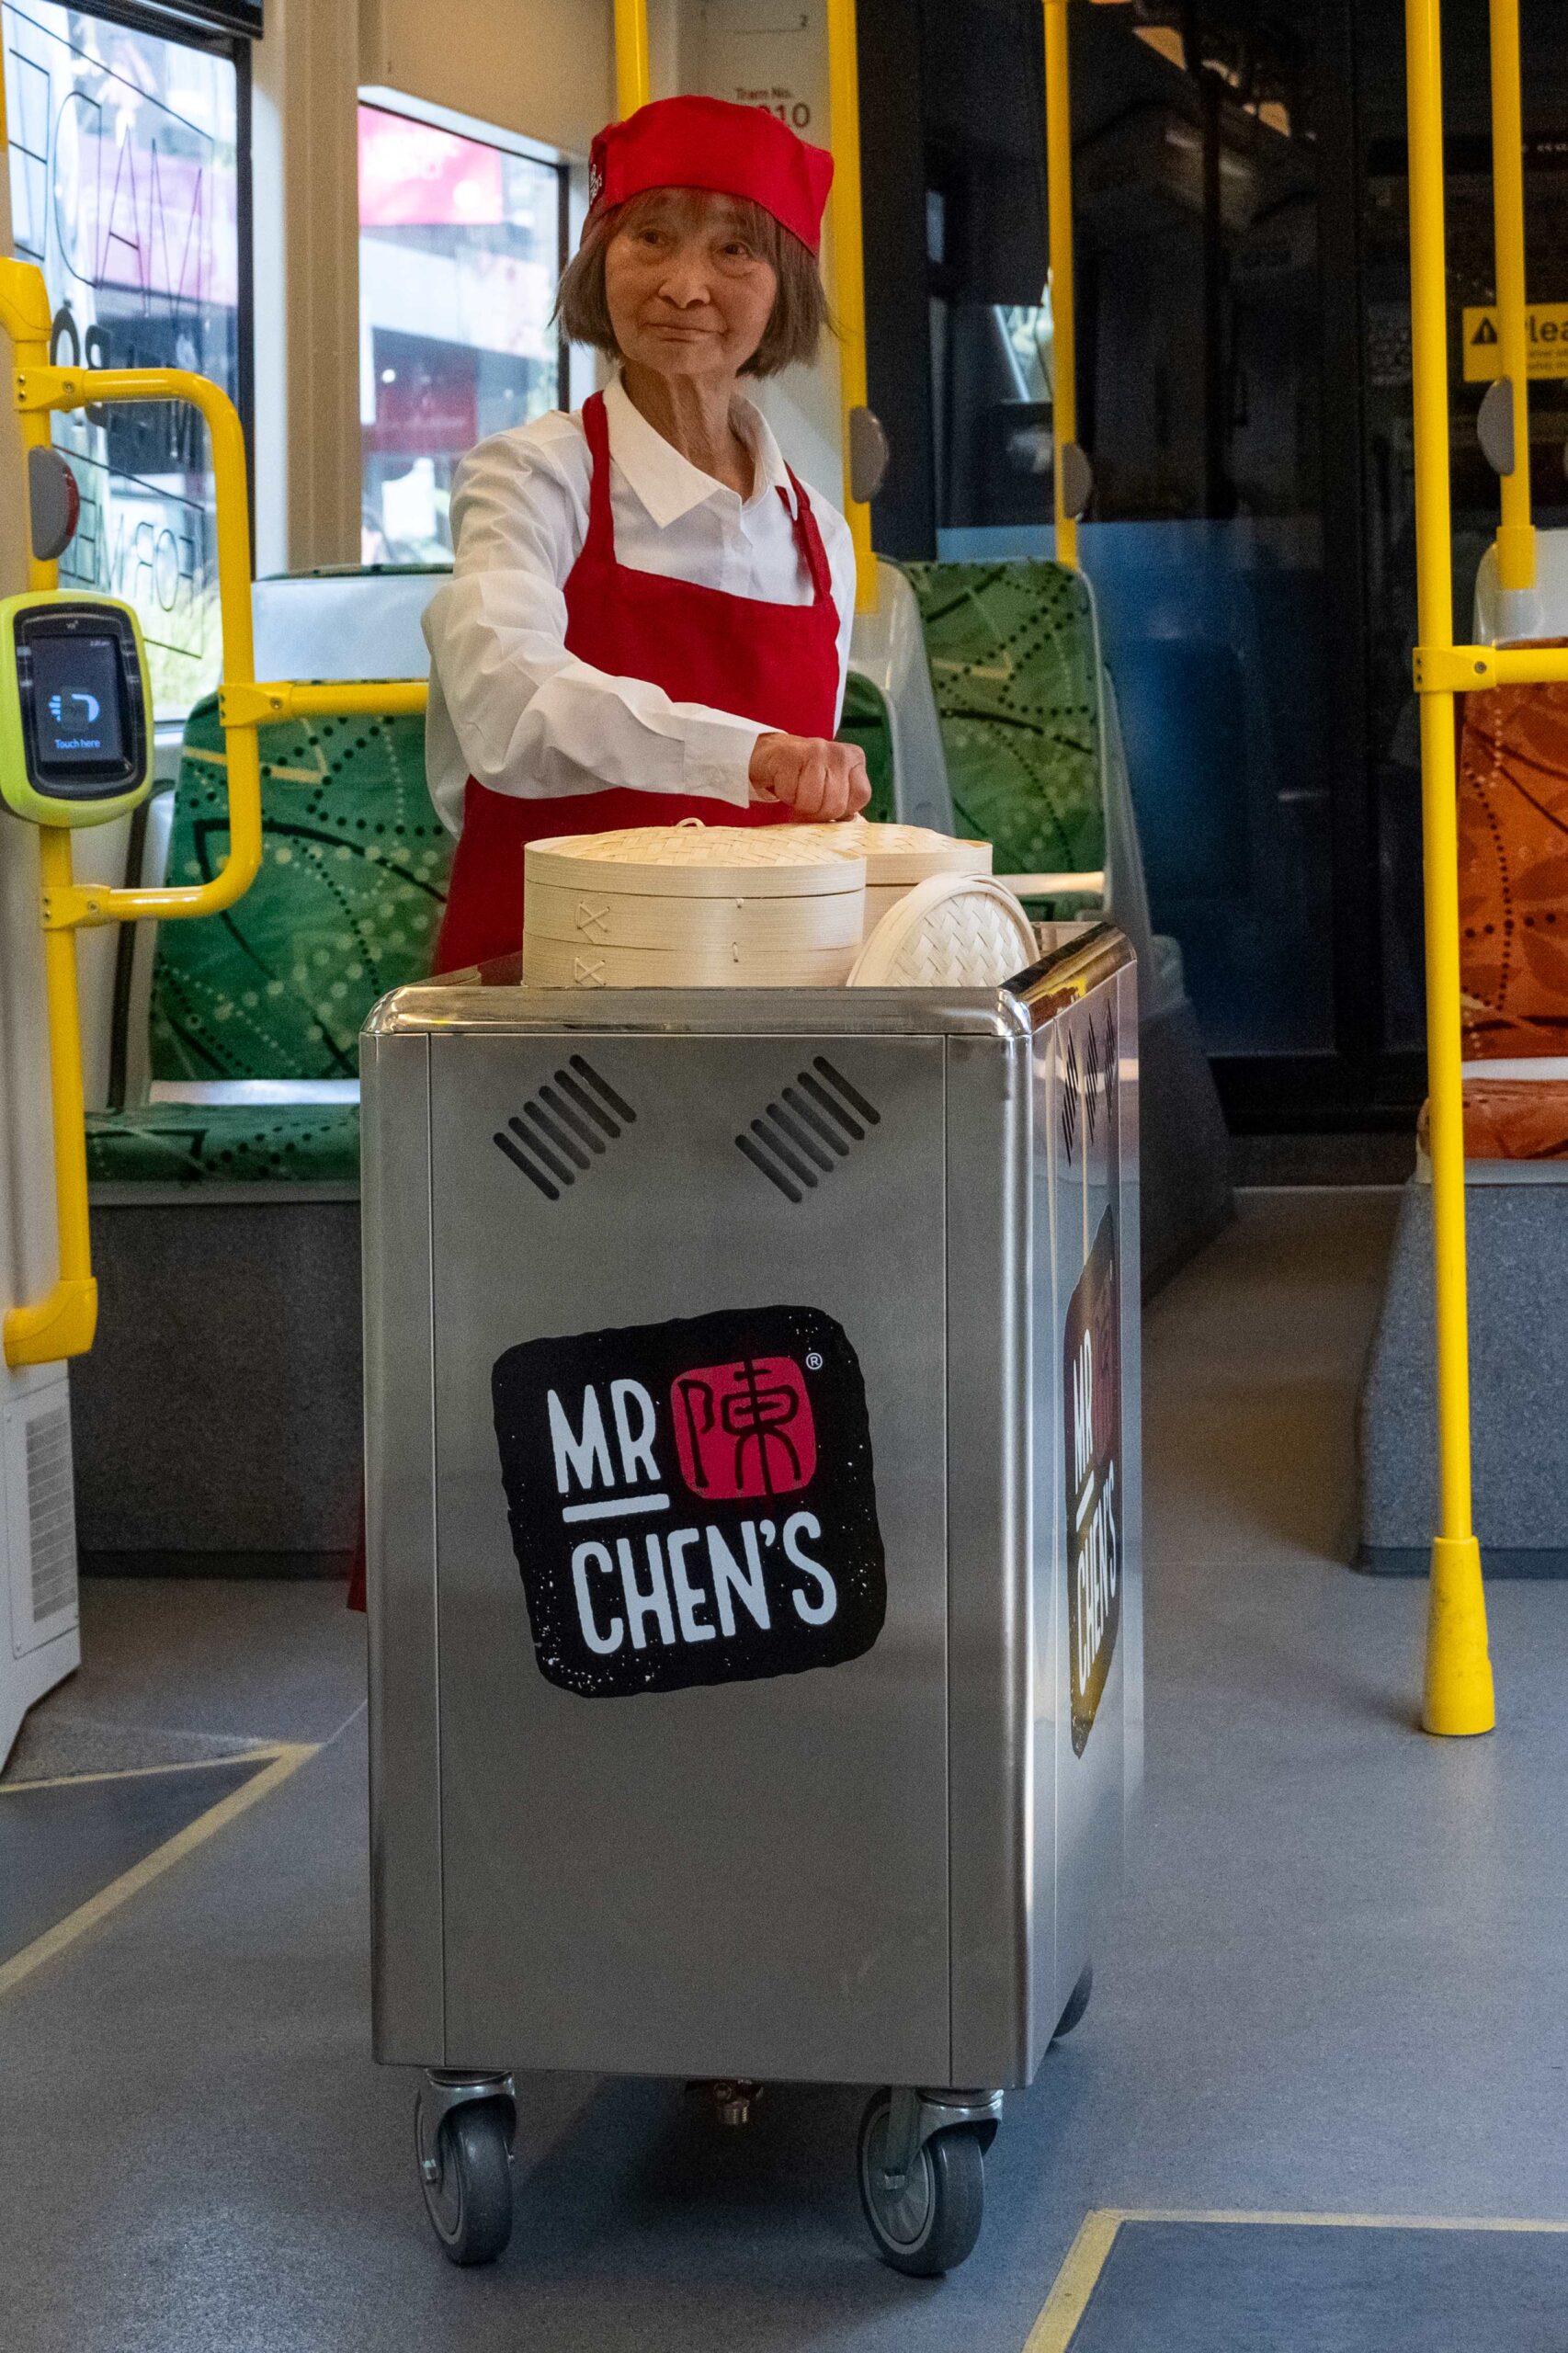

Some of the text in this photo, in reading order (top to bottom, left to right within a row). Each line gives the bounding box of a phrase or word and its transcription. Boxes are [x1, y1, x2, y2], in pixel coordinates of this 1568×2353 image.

[757, 102, 811, 129] 10
[54, 738, 101, 750] Touch here
[547, 1378, 662, 1494] MR
[1074, 1328, 1094, 1495] MR
[571, 1510, 837, 1654] CHEN'S
[1077, 1459, 1117, 1697] CHEN'S
